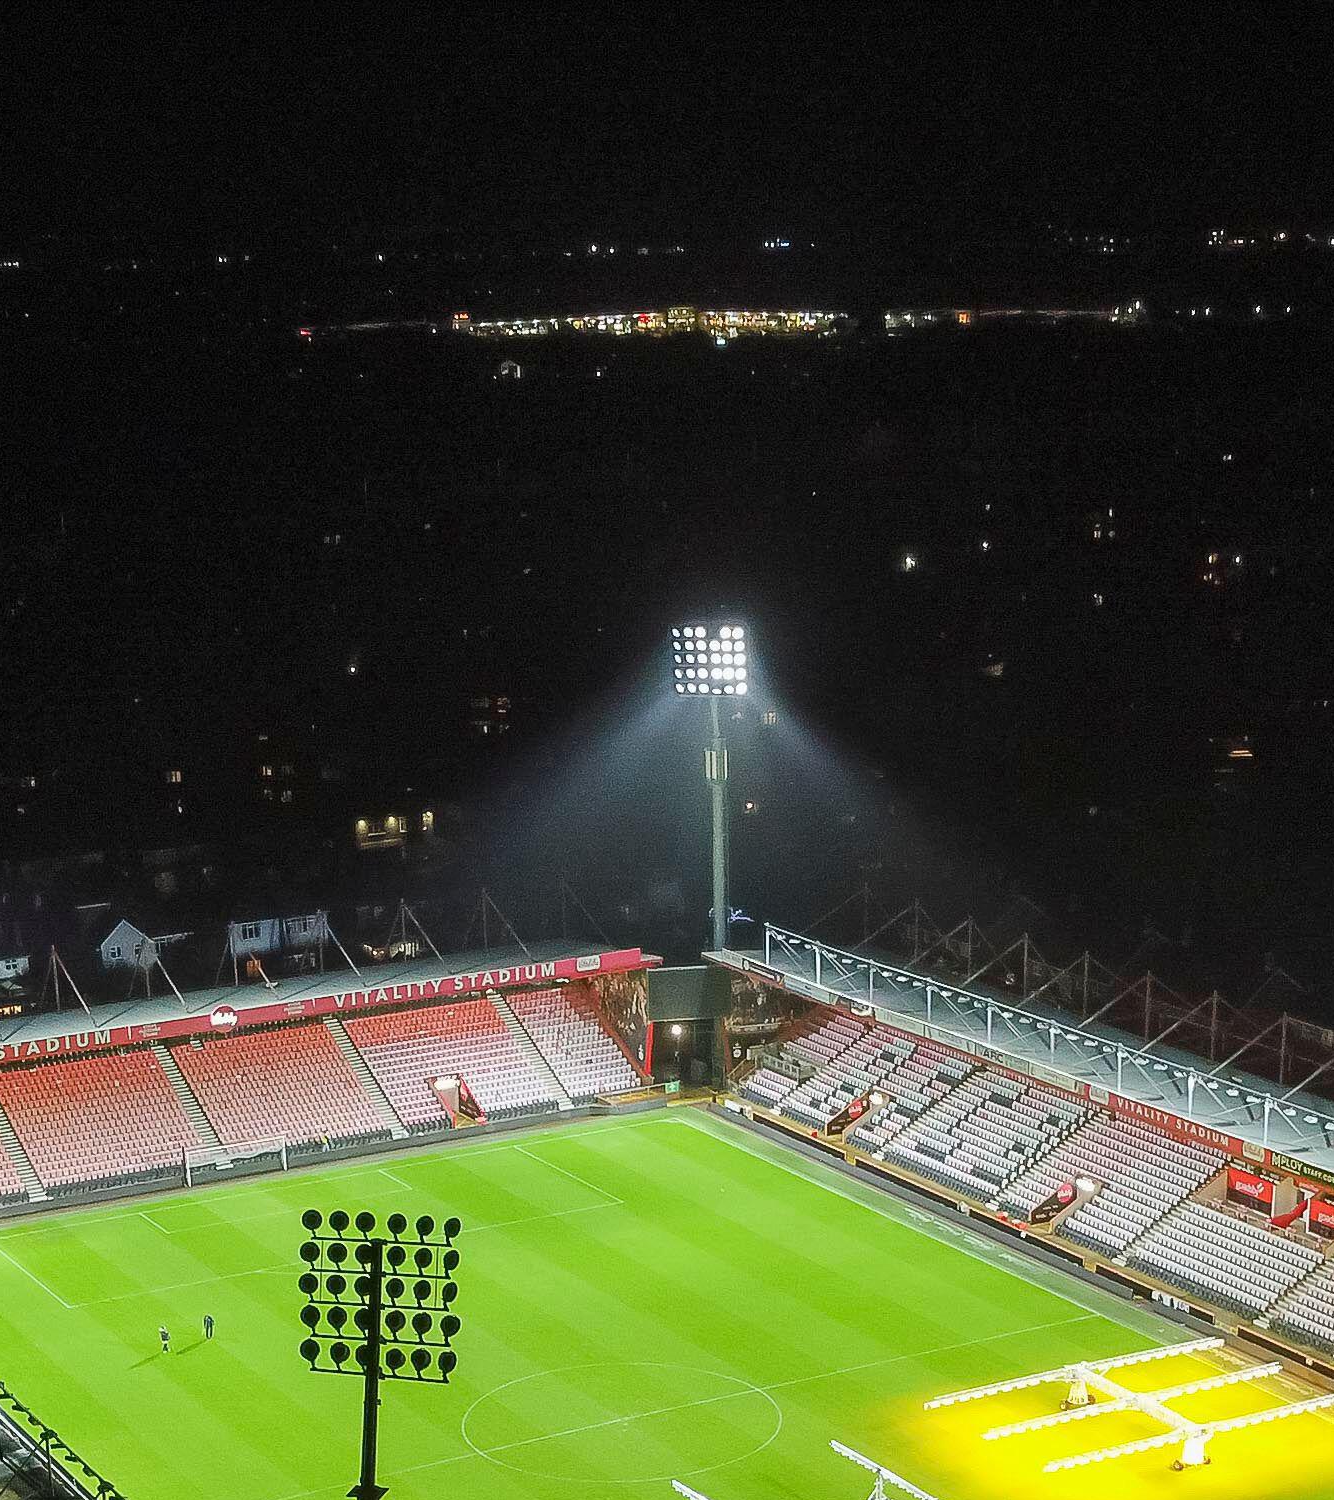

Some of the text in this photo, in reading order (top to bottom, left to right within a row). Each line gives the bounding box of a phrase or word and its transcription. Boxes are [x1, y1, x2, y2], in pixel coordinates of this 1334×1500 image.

[334, 979, 443, 1008] VITALITY
[453, 962, 556, 991] STADIUM
[1117, 1098, 1229, 1147] VITALITY STADIUM
